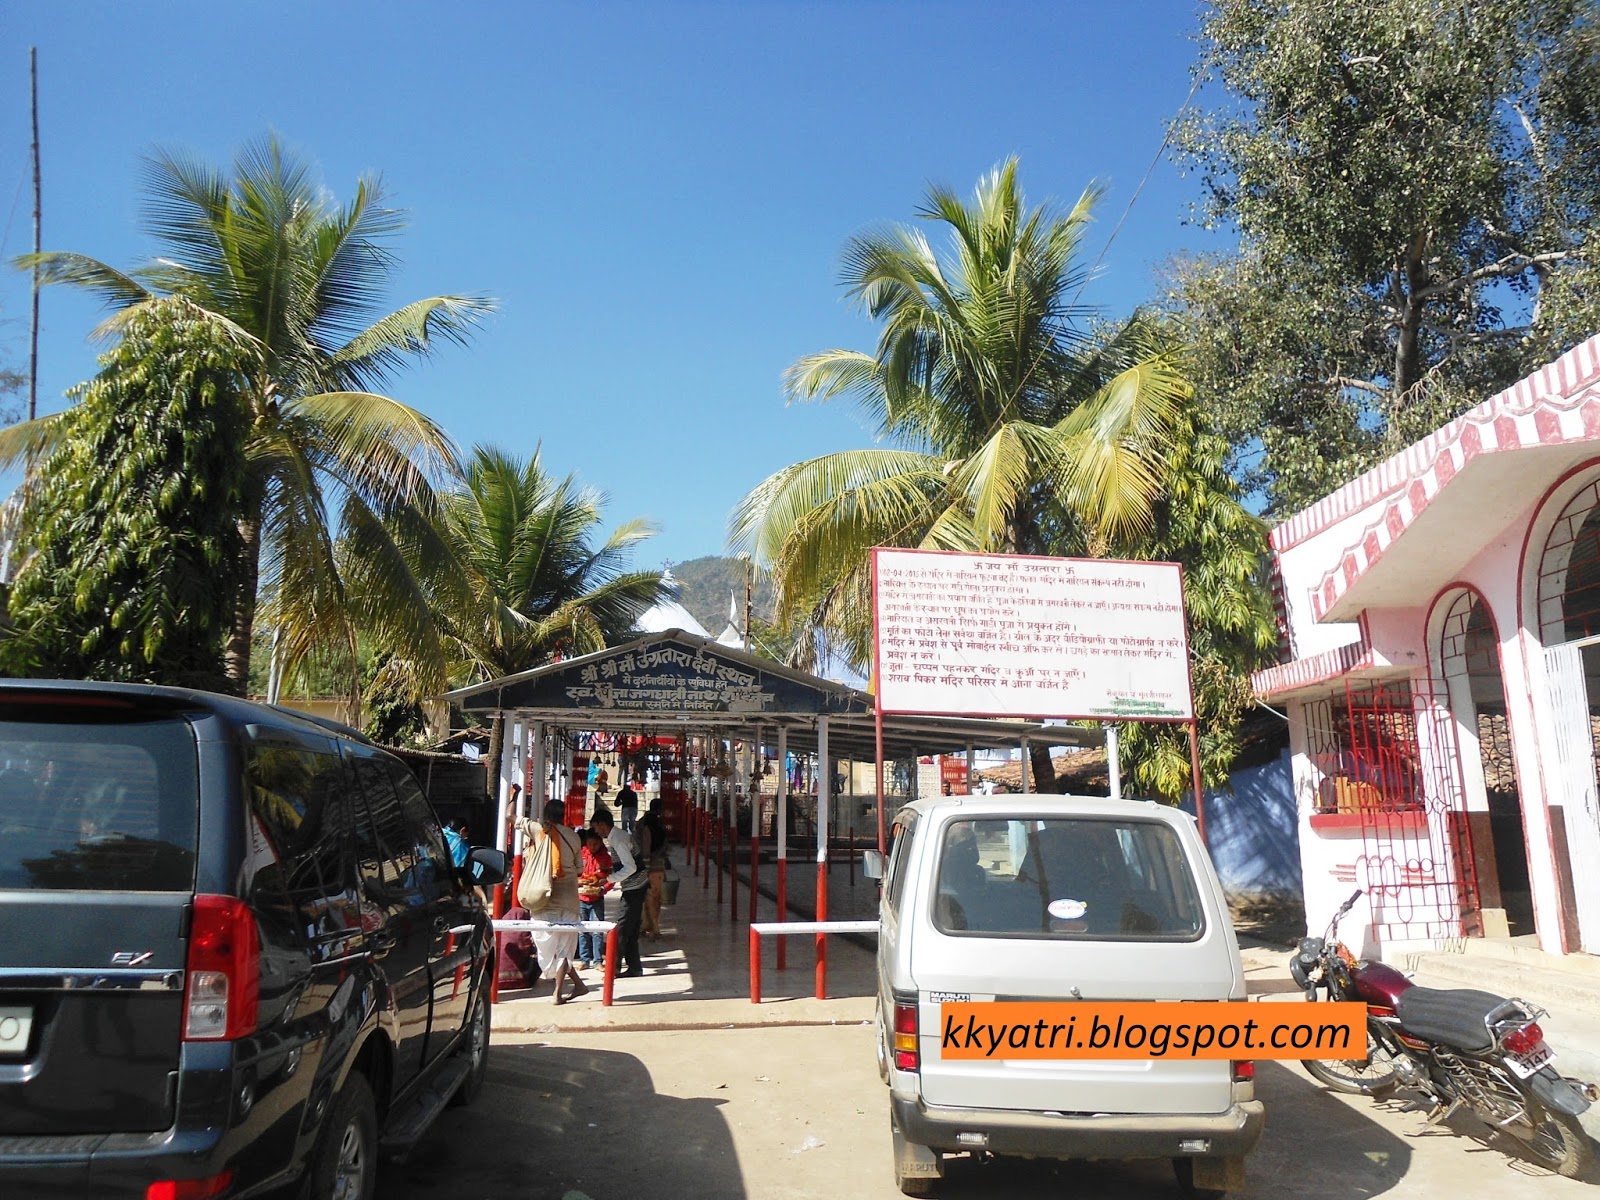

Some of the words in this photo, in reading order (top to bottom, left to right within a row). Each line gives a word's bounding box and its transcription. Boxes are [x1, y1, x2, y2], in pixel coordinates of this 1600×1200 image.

[581, 664, 598, 683] श्री
[601, 659, 618, 678] श्री
[619, 653, 636, 672] माँ
[637, 648, 693, 668] उग्रतारा
[692, 652, 718, 674] देवी
[716, 665, 756, 687] स्थल
[688, 676, 714, 690] सुविधा
[687, 690, 719, 700] नाथ
[930, 991, 970, 999] MARUTI
